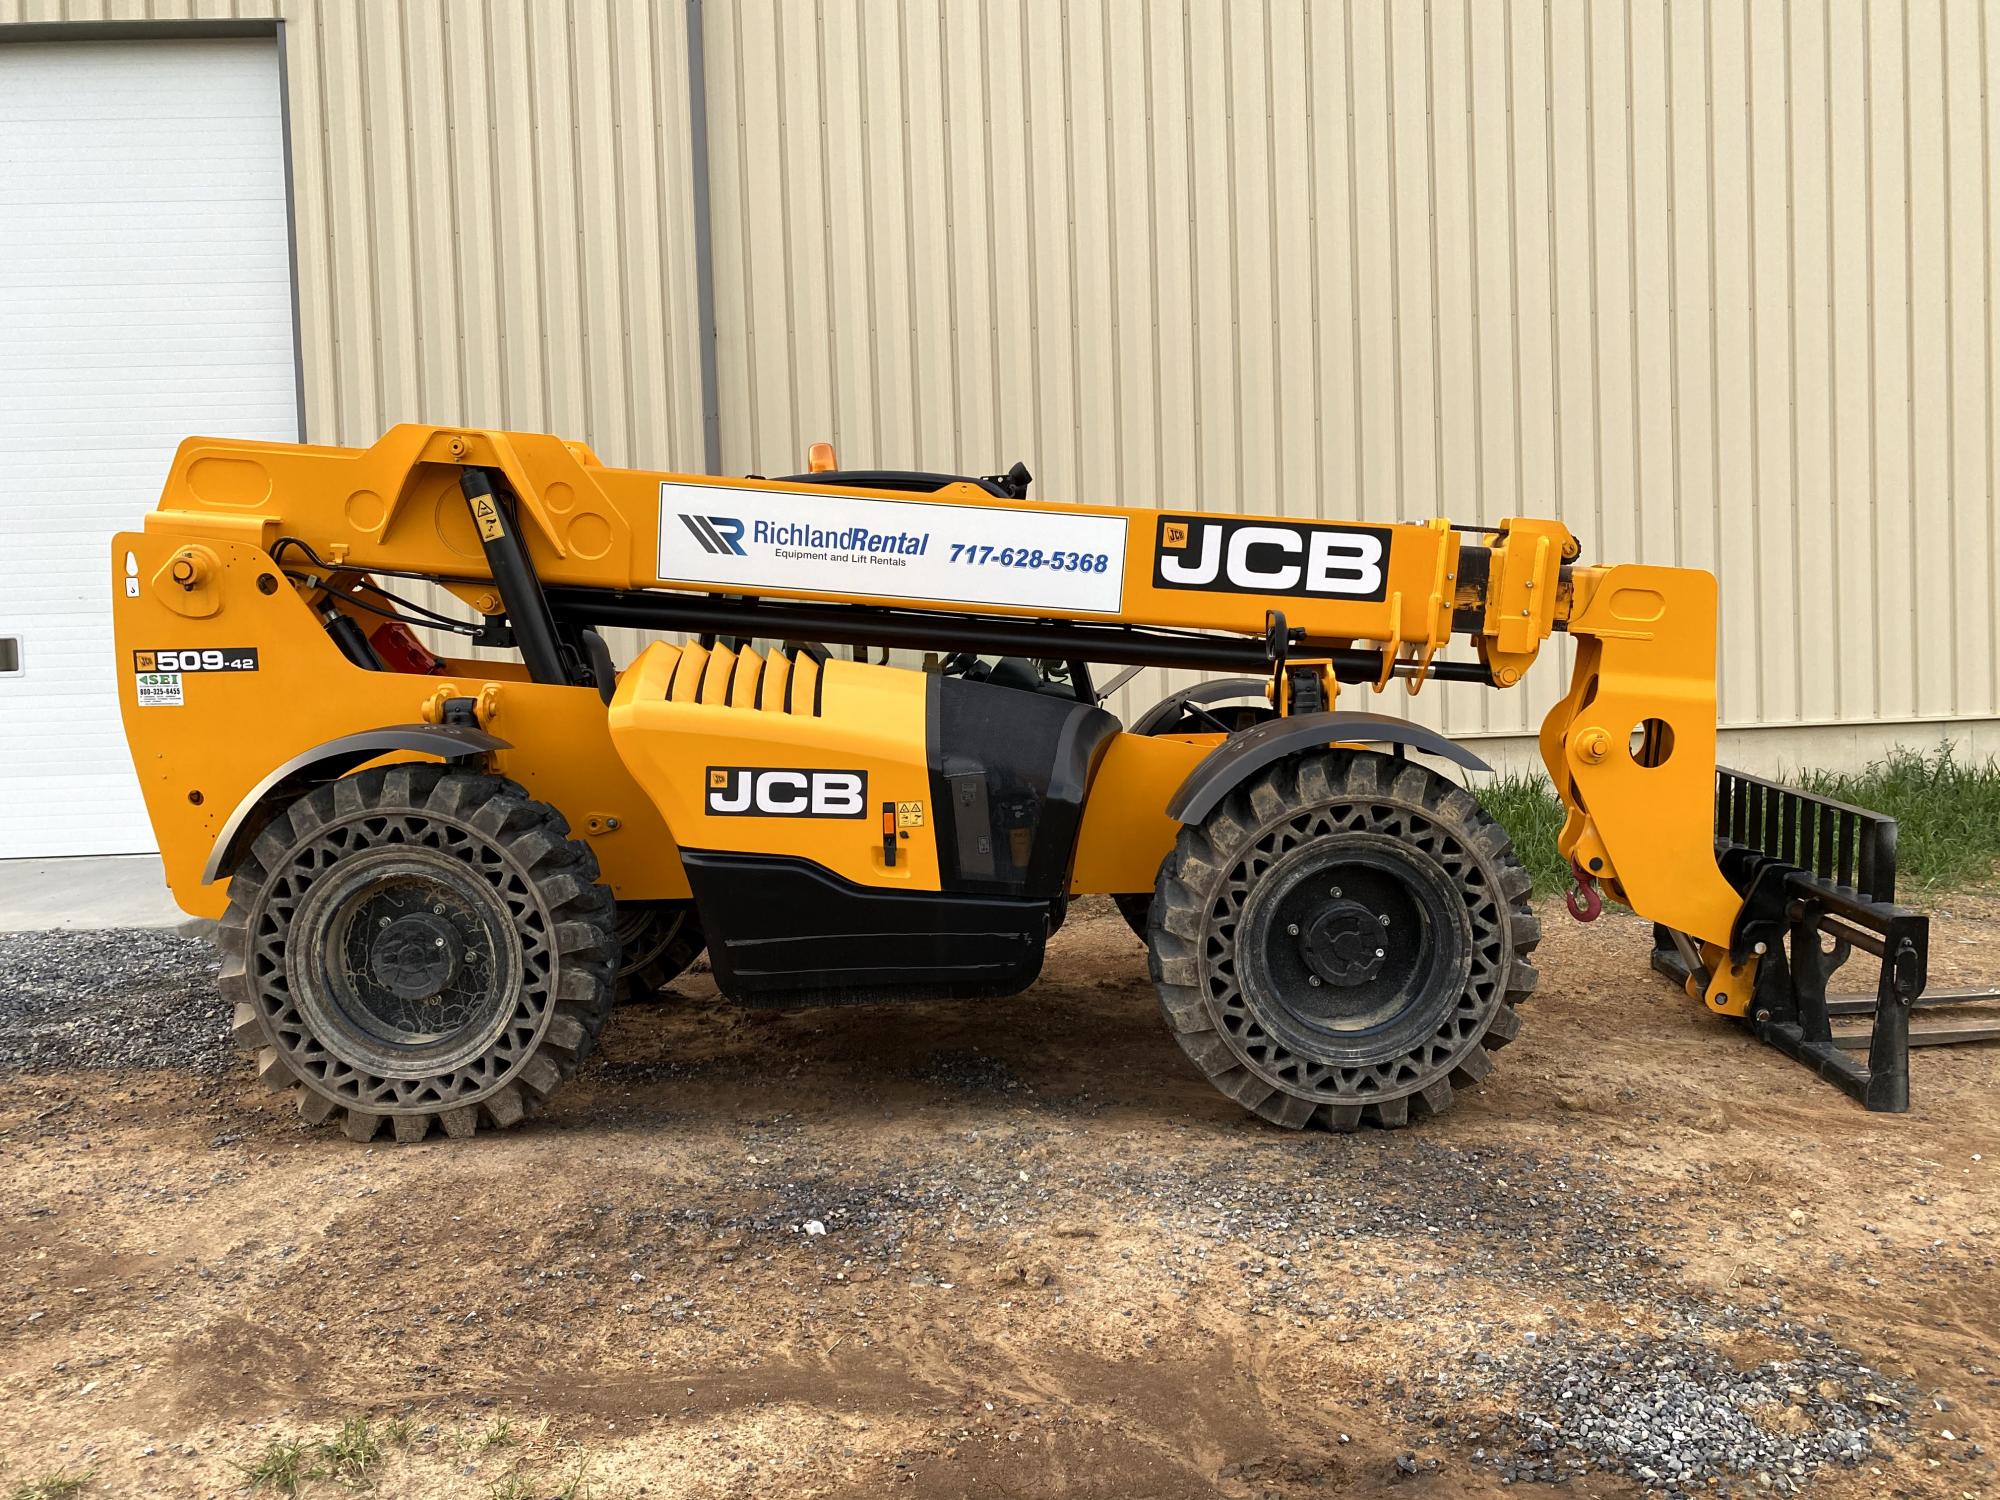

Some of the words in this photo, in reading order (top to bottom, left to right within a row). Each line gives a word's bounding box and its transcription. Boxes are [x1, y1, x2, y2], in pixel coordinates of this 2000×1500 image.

[753, 520, 930, 556] RichlandRental
[1167, 527, 1185, 543] JCB
[775, 548, 828, 561] Equipment
[830, 552, 849, 562] and
[851, 554, 867, 564] Lift
[870, 556, 907, 567] Rentals
[949, 543, 1109, 573] 717-628-5368
[1160, 524, 1383, 594] JCB
[157, 650, 254, 671] 509-42
[148, 674, 179, 685] SEI
[709, 771, 863, 814] JCB
